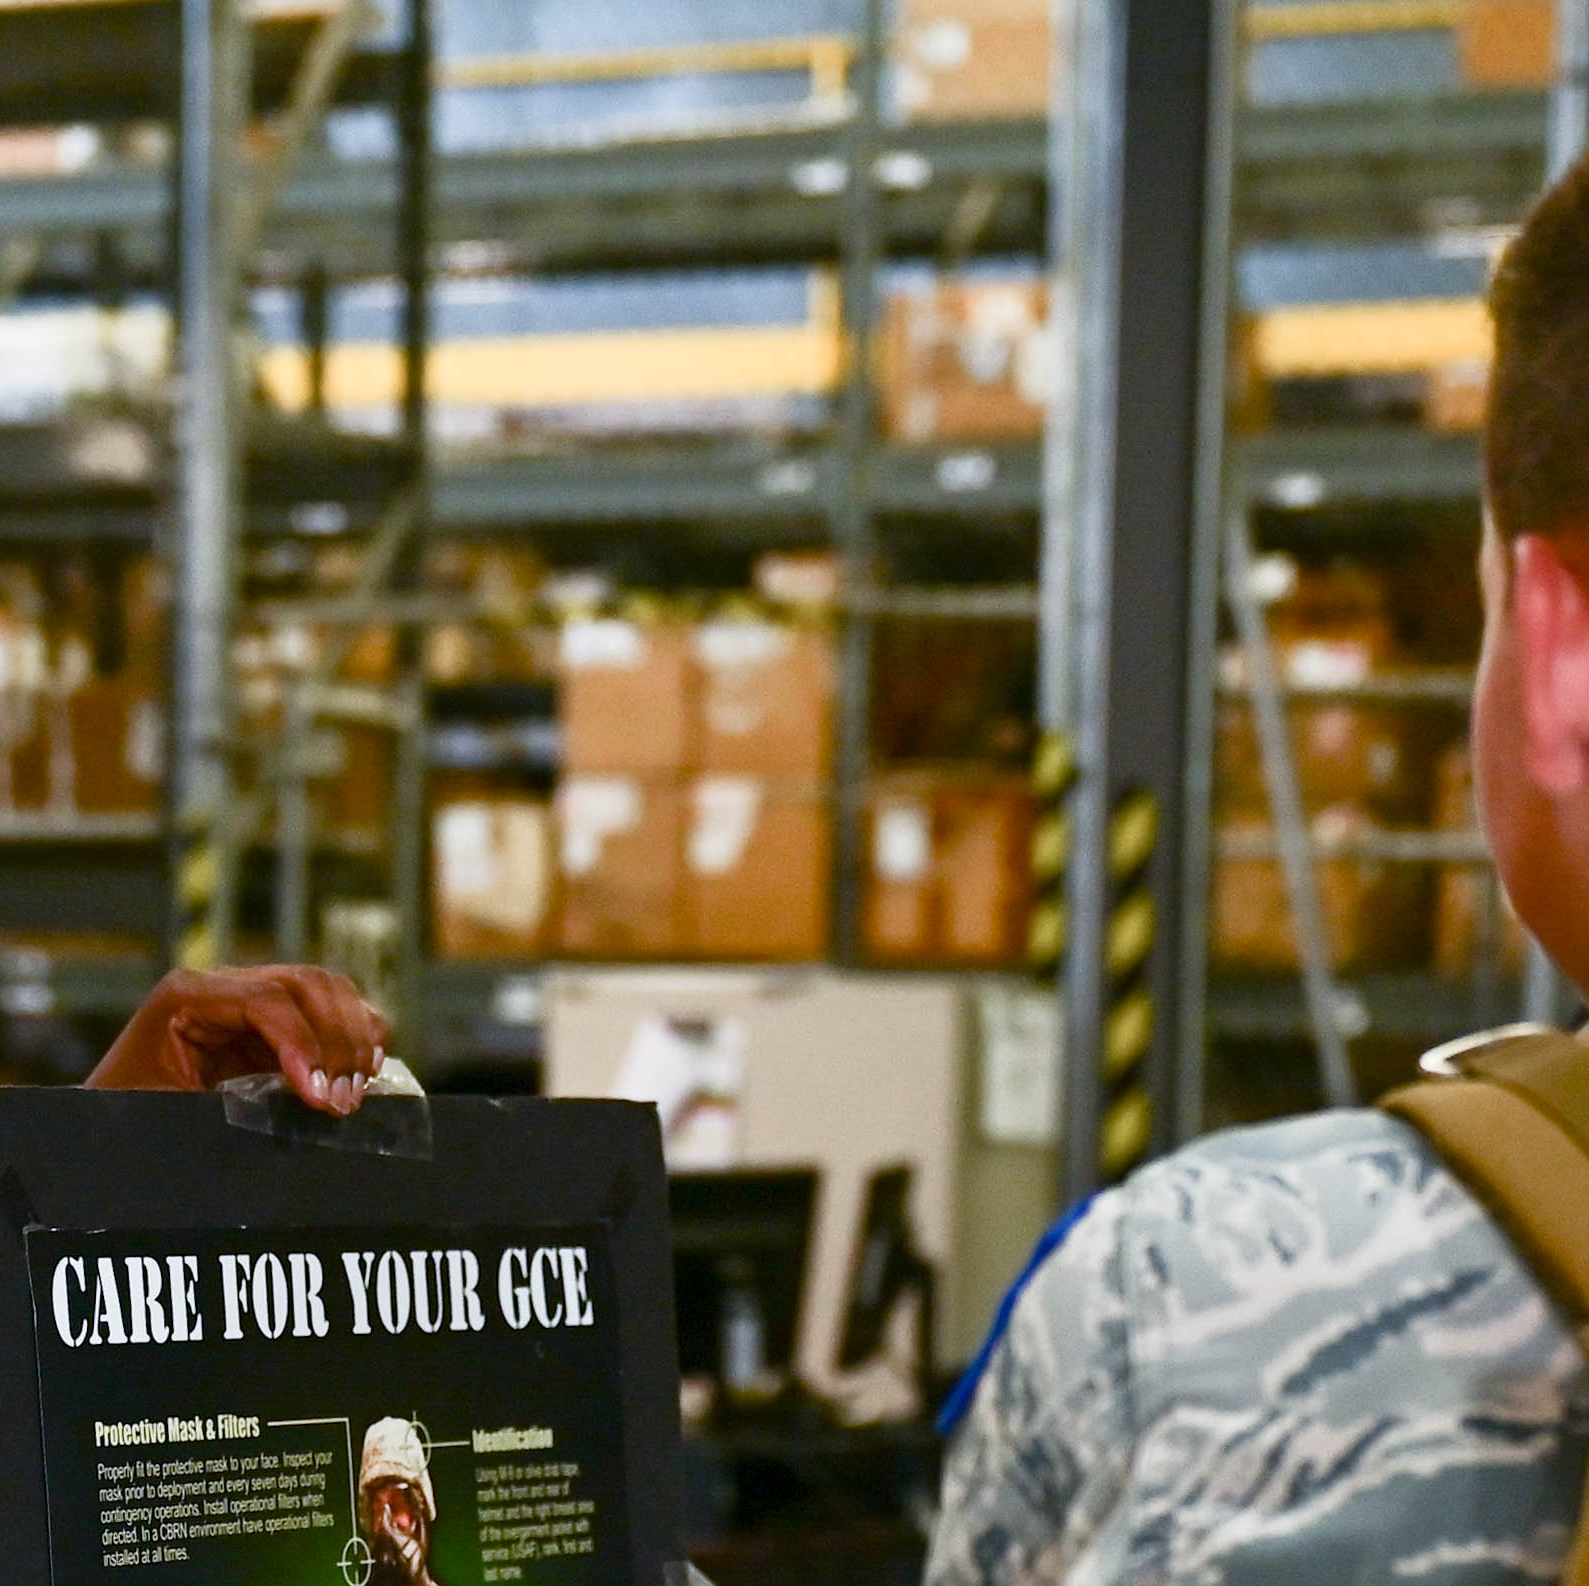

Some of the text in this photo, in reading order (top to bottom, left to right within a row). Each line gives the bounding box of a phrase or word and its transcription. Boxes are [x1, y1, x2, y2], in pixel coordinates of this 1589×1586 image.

[52, 1247, 594, 1347] CARE FOR YOUR GCE
[95, 1413, 260, 1447] Protective Mask & Filters
[472, 1425, 553, 1453] Identification
[97, 1461, 134, 1484] Properly
[136, 1460, 145, 1478] fit
[146, 1460, 160, 1477] the
[162, 1457, 204, 1480] protective
[206, 1455, 228, 1472] mask
[230, 1456, 239, 1471] to
[241, 1457, 259, 1474] your
[283, 1450, 313, 1470] Inspect
[315, 1452, 332, 1469] your
[99, 1471, 325, 1504] mask prior to deployment and every seven days during
[100, 1506, 151, 1525] contingency
[154, 1502, 201, 1523] operations.
[203, 1497, 228, 1515] Install
[230, 1494, 276, 1516] operational
[277, 1492, 300, 1509] filters
[102, 1511, 334, 1545] directed. In a CBRN environment have operational filters
[103, 1545, 190, 1567] installed at all times.
